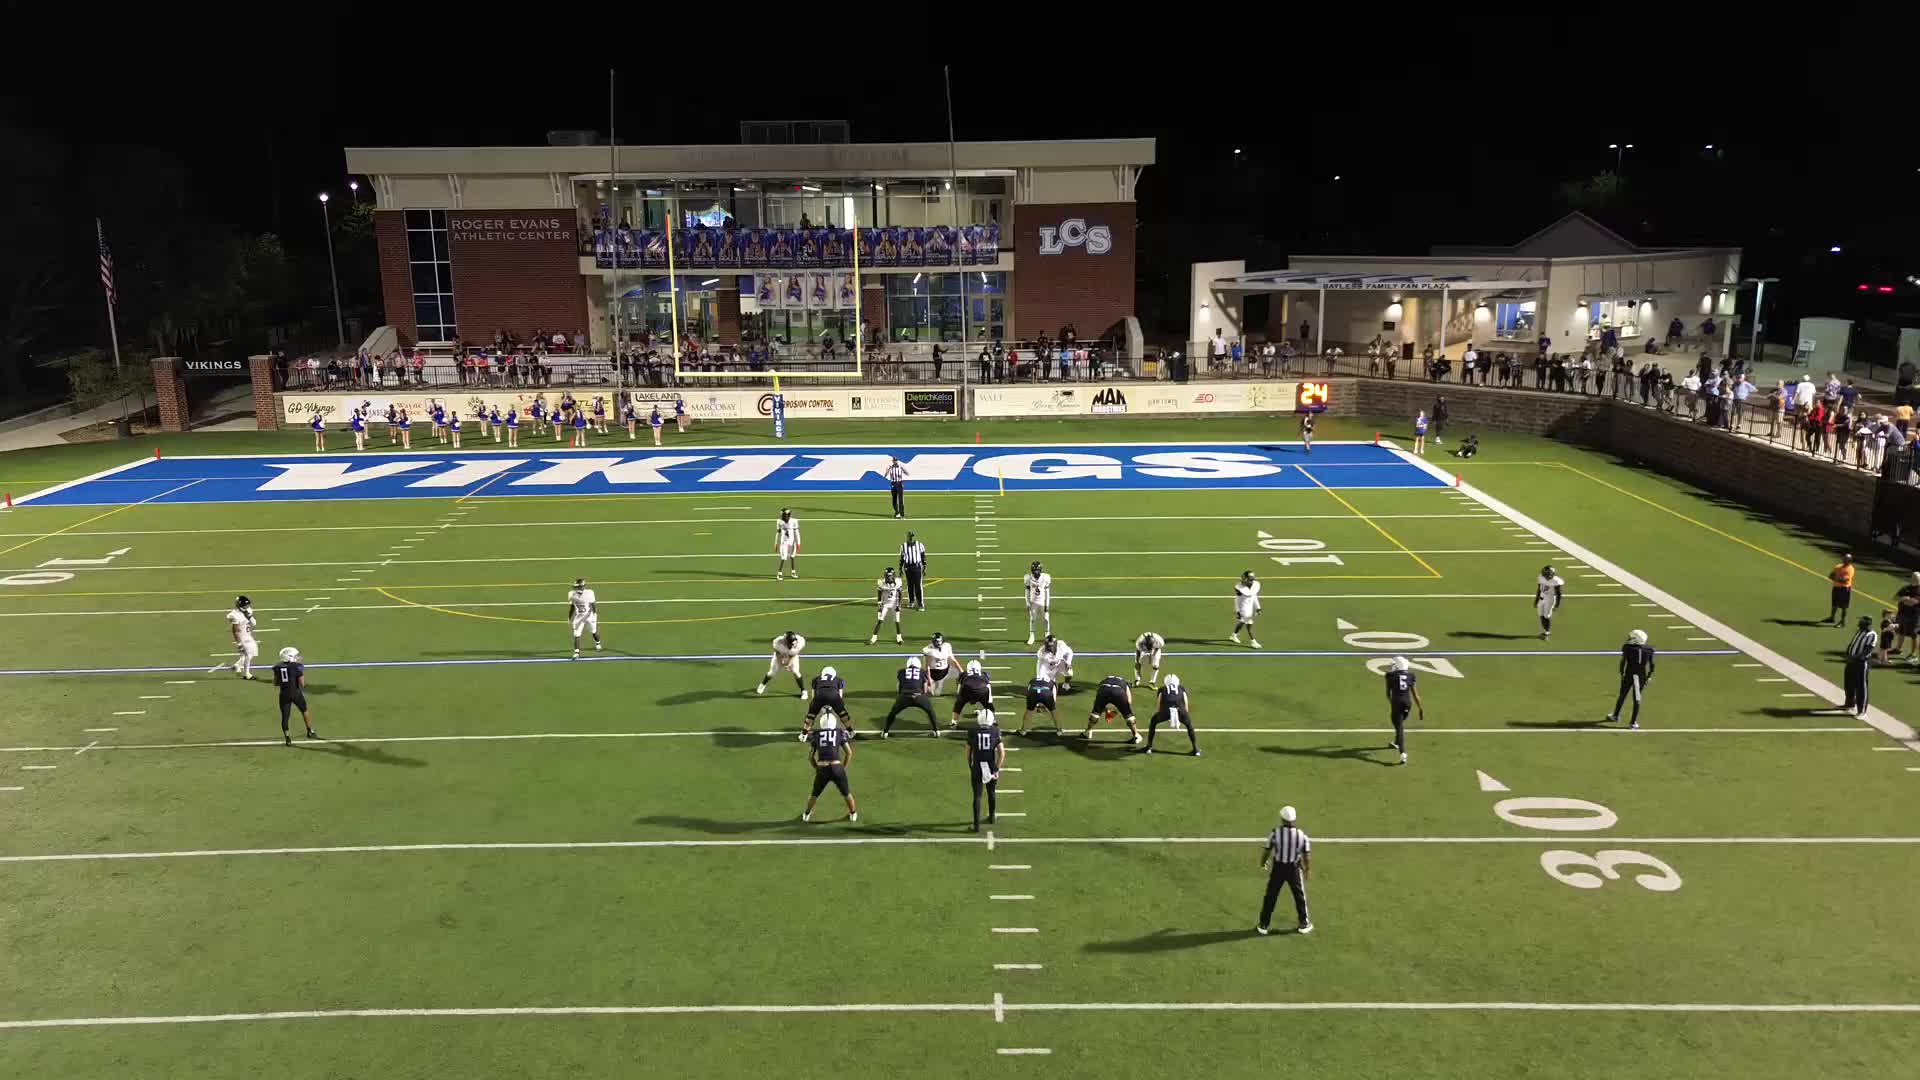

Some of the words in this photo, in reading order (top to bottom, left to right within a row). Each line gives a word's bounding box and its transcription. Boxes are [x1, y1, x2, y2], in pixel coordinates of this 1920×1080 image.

[452, 220, 504, 230] ROGER
[510, 219, 560, 229] EVANS
[454, 232, 515, 240] ATHLETIC
[519, 232, 570, 240] CENTER
[1039, 218, 1111, 255] LCS
[186, 361, 242, 370] VIKINGS
[1300, 382, 1328, 405] 24
[809, 400, 834, 408] CONTROL
[773, 395, 783, 438] VIKINGS
[256, 452, 1282, 491] VIKINGS
[1258, 538, 1344, 565] 10
[1342, 631, 1465, 678] 20
[1637, 648, 1643, 664] 1
[280, 667, 289, 683] 0
[905, 668, 920, 680] 55
[1399, 675, 1408, 690] 5
[819, 730, 837, 747] 24
[977, 733, 991, 750] 10
[1493, 797, 1682, 892] 30
